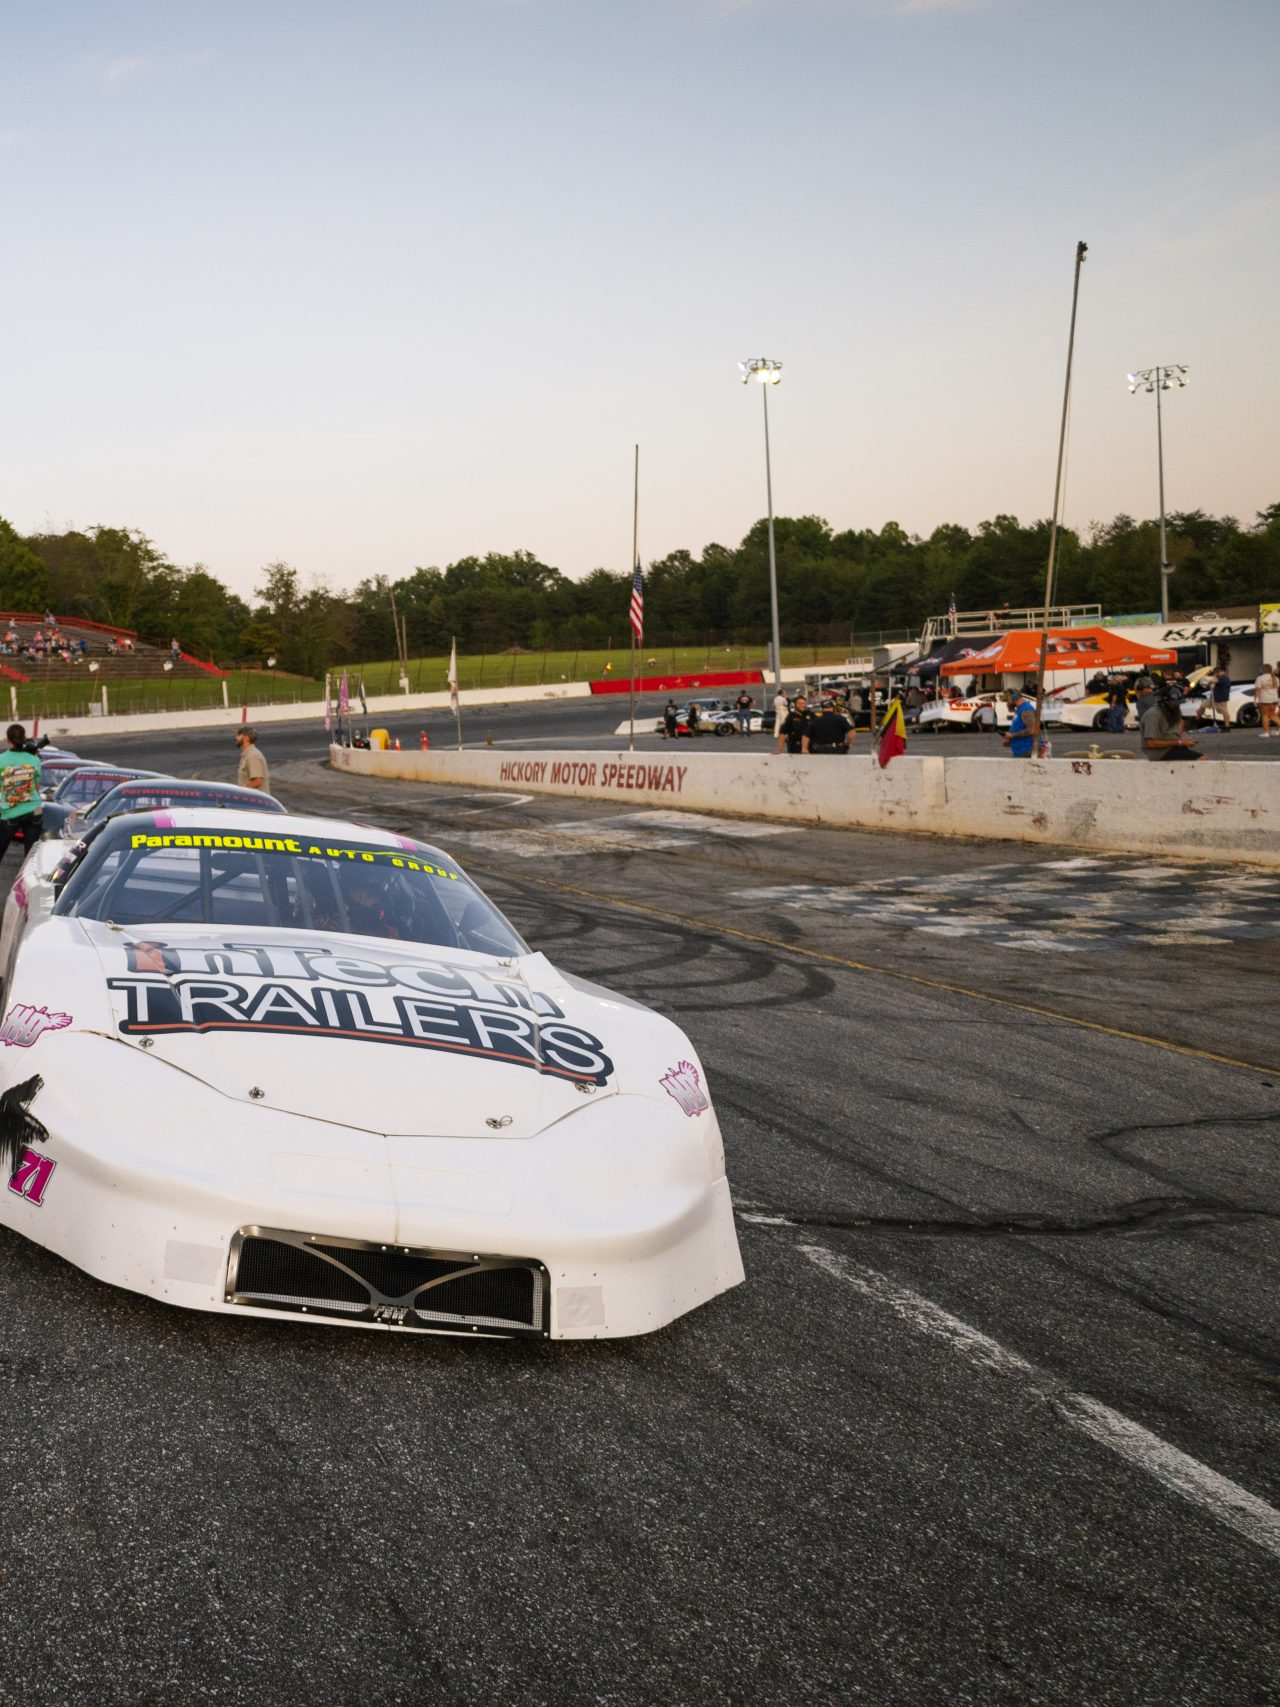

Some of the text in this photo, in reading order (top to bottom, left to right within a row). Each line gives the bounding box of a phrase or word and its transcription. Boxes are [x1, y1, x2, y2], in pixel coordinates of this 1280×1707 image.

[500, 761, 688, 792] HICKORY MOTOR SPEEDWAY
[131, 834, 459, 880] Paramount AUTO GROUP
[109, 978, 610, 1076] TRAILERS
[8, 1144, 57, 1207] 71
